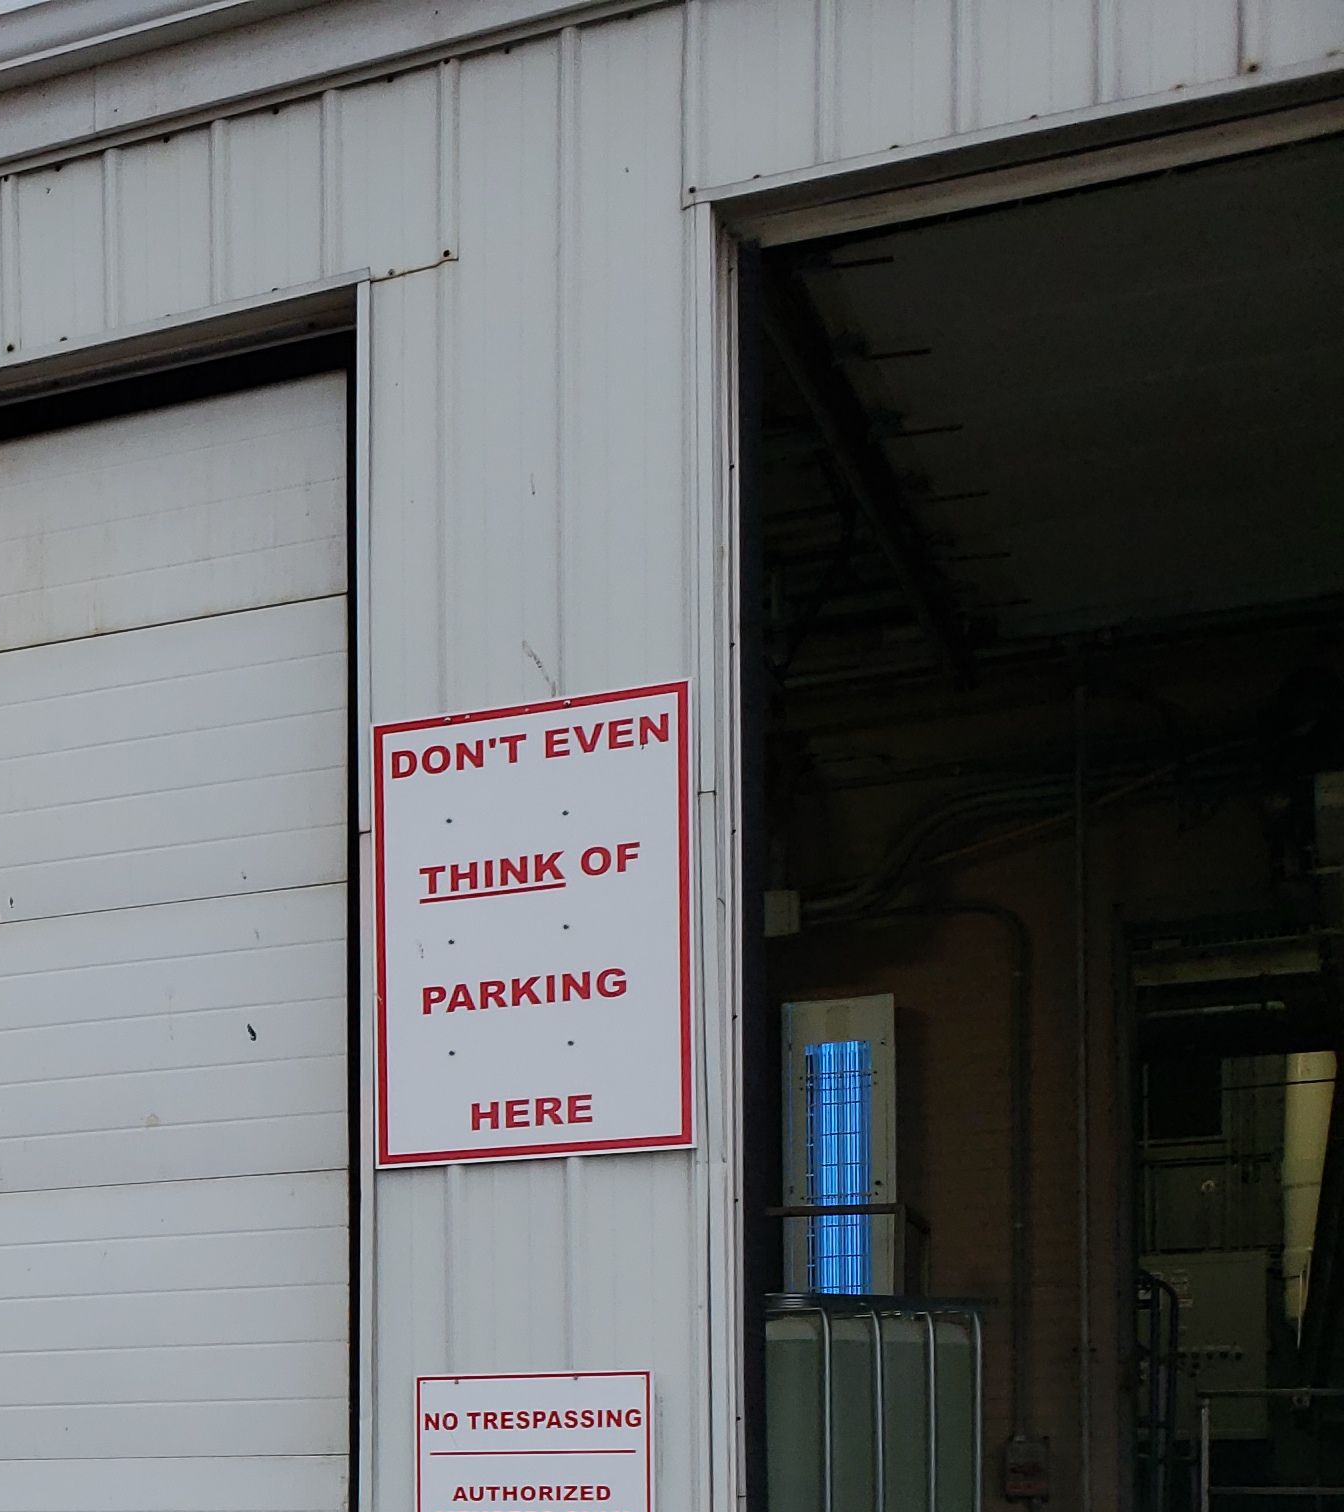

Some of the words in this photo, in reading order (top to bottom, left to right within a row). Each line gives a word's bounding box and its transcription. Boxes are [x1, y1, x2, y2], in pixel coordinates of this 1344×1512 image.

[390, 733, 527, 780] DON'T
[544, 712, 670, 760] EVEN
[419, 851, 565, 895] THINK
[580, 842, 641, 876] OF
[422, 968, 627, 1015] PARKING
[471, 1094, 593, 1131] HERE
[424, 1412, 458, 1431] NO
[467, 1408, 642, 1430] TRESPASSING
[452, 1485, 611, 1502] AUTHORIZED
